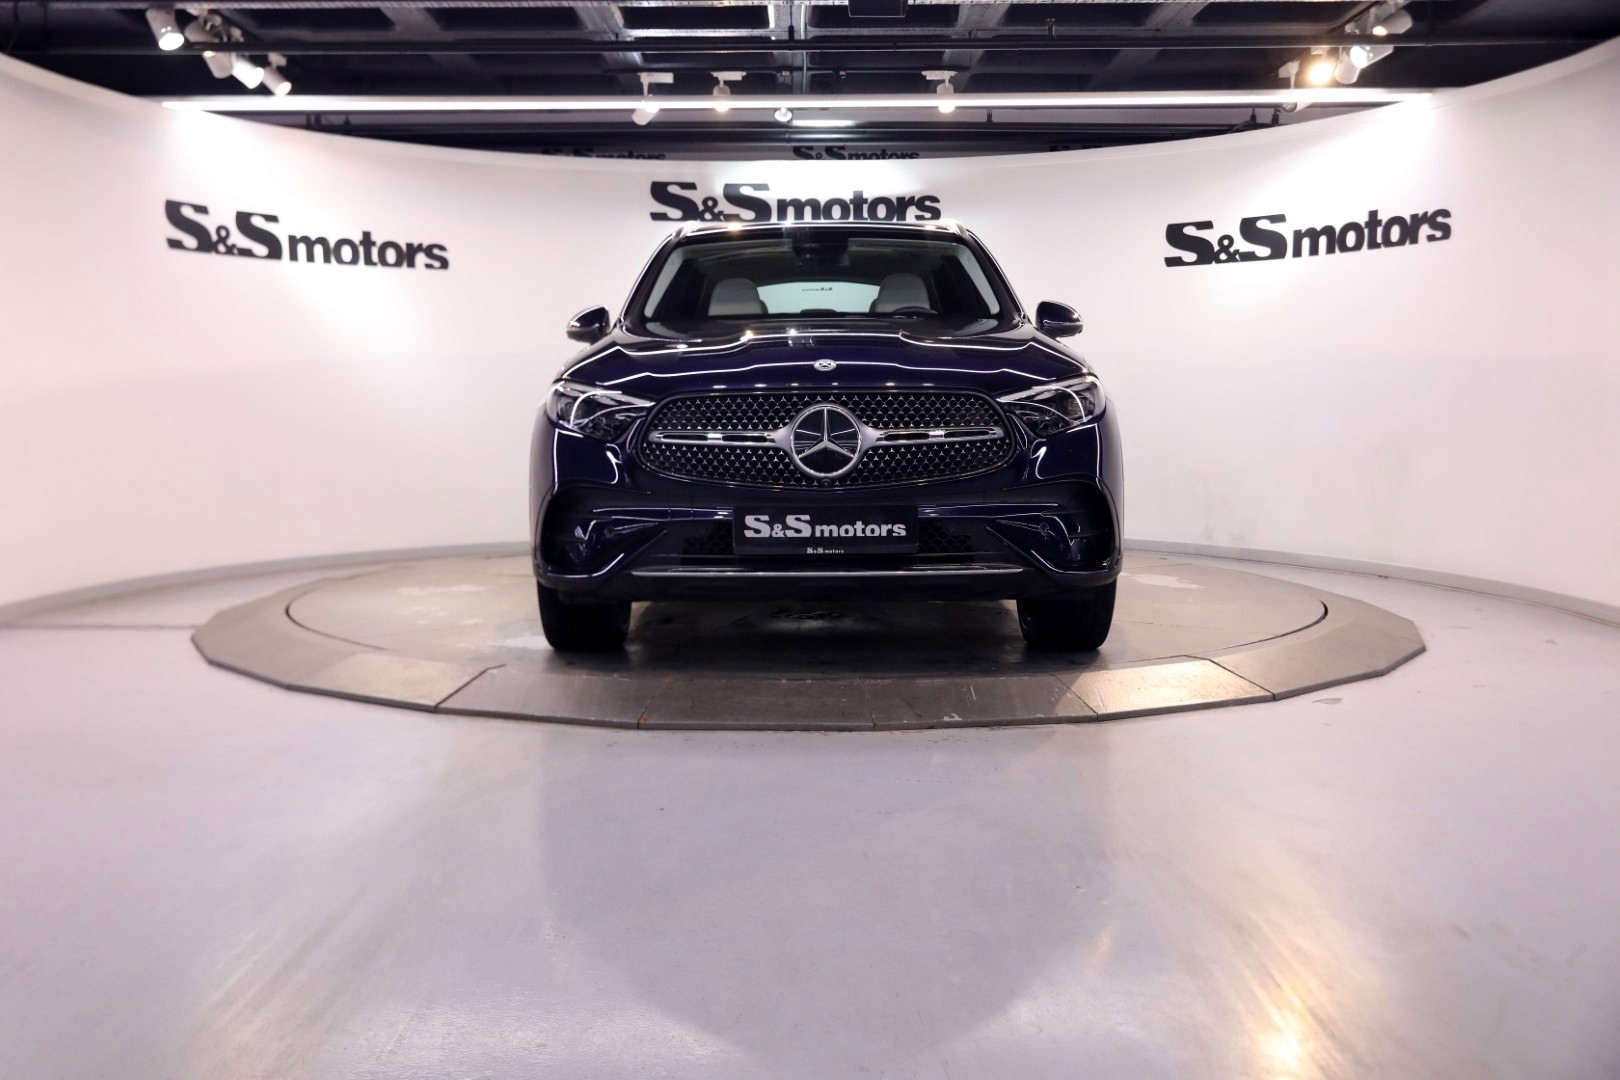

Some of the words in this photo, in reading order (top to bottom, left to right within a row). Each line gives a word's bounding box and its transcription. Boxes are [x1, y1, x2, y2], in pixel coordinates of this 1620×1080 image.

[650, 181, 772, 222] S&S
[777, 190, 942, 221] motors
[165, 199, 283, 260] S&S
[288, 230, 450, 270] motors
[1164, 213, 1288, 267] S&S
[1292, 208, 1452, 259] motors
[744, 514, 812, 538] S&S
[815, 520, 907, 538] motors
